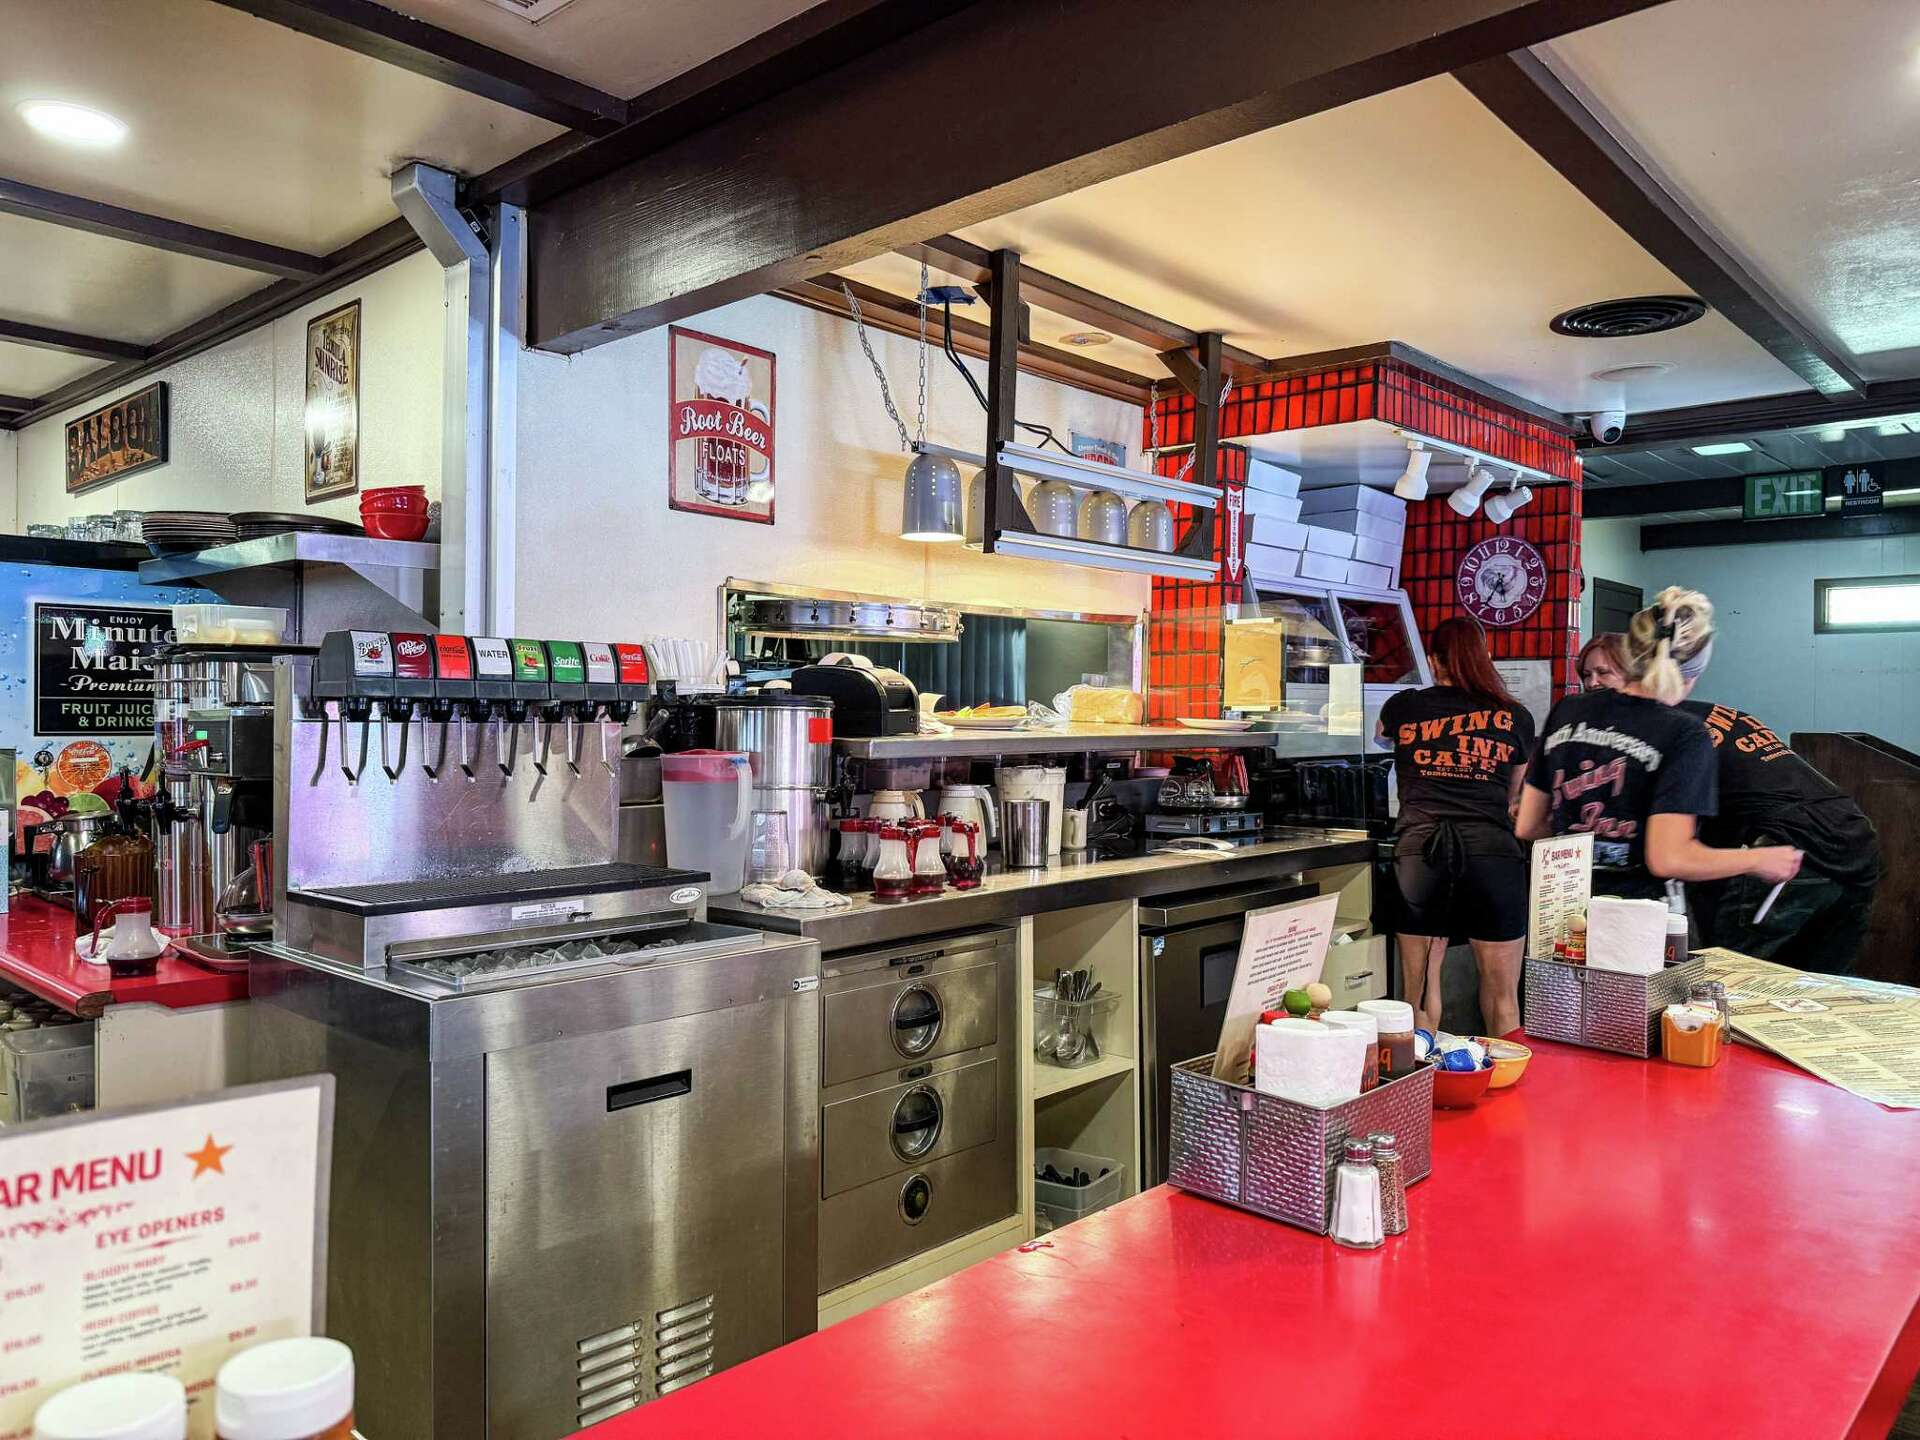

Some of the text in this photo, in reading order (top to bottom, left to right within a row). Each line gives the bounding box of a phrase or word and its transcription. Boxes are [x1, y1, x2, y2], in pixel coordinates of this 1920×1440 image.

[314, 347, 349, 385] SUNRISE
[680, 406, 766, 449] Root Beer
[702, 441, 746, 466] FLOATS
[1754, 475, 1816, 516] EXIT
[1496, 540, 1510, 553] 12
[1465, 557, 1479, 571] 10
[49, 616, 178, 643] Minute
[109, 616, 144, 625] ENJOY
[401, 642, 425, 656] Pepper
[479, 649, 509, 659] WATER
[554, 656, 580, 666] Sprite
[589, 653, 612, 663] Coke
[61, 703, 153, 715] FRUIT JUIC
[78, 716, 154, 727] & DRINKS
[1398, 710, 1514, 745] SWING
[1413, 749, 1497, 774] CAFE
[1456, 735, 1515, 763] INN
[0, 1148, 163, 1209] AR MENU
[95, 1206, 226, 1250] EYE OPENERS
